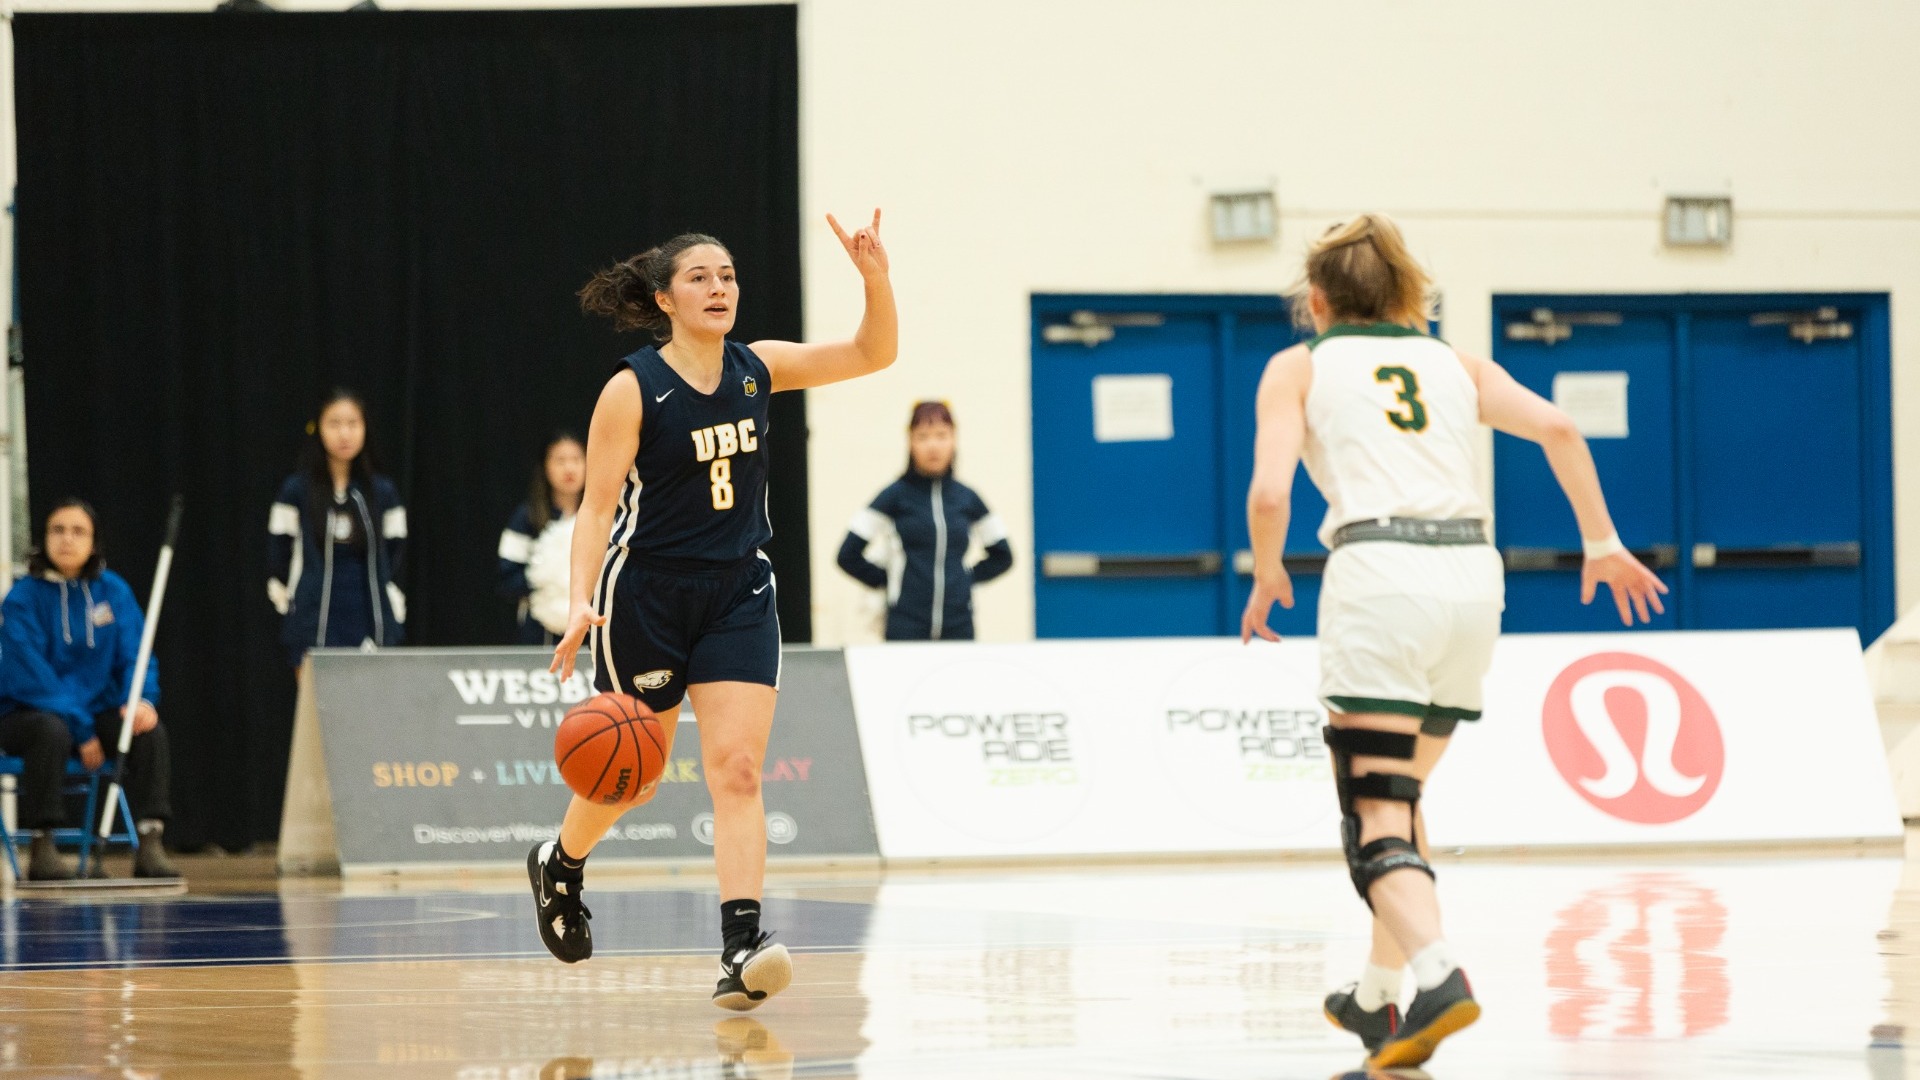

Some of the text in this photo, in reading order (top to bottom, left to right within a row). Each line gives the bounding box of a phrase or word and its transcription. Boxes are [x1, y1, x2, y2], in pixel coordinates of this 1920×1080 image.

[1374, 365, 1429, 434] 3
[691, 418, 758, 462] UBC
[709, 458, 734, 511] 8
[447, 668, 602, 704] WESB
[906, 712, 1070, 738] POWER
[1166, 708, 1322, 734] POWER
[982, 738, 1072, 762] RIDE
[1240, 735, 1326, 759] RIDE
[371, 761, 460, 787] SHOP
[987, 767, 1079, 787] ZERO
